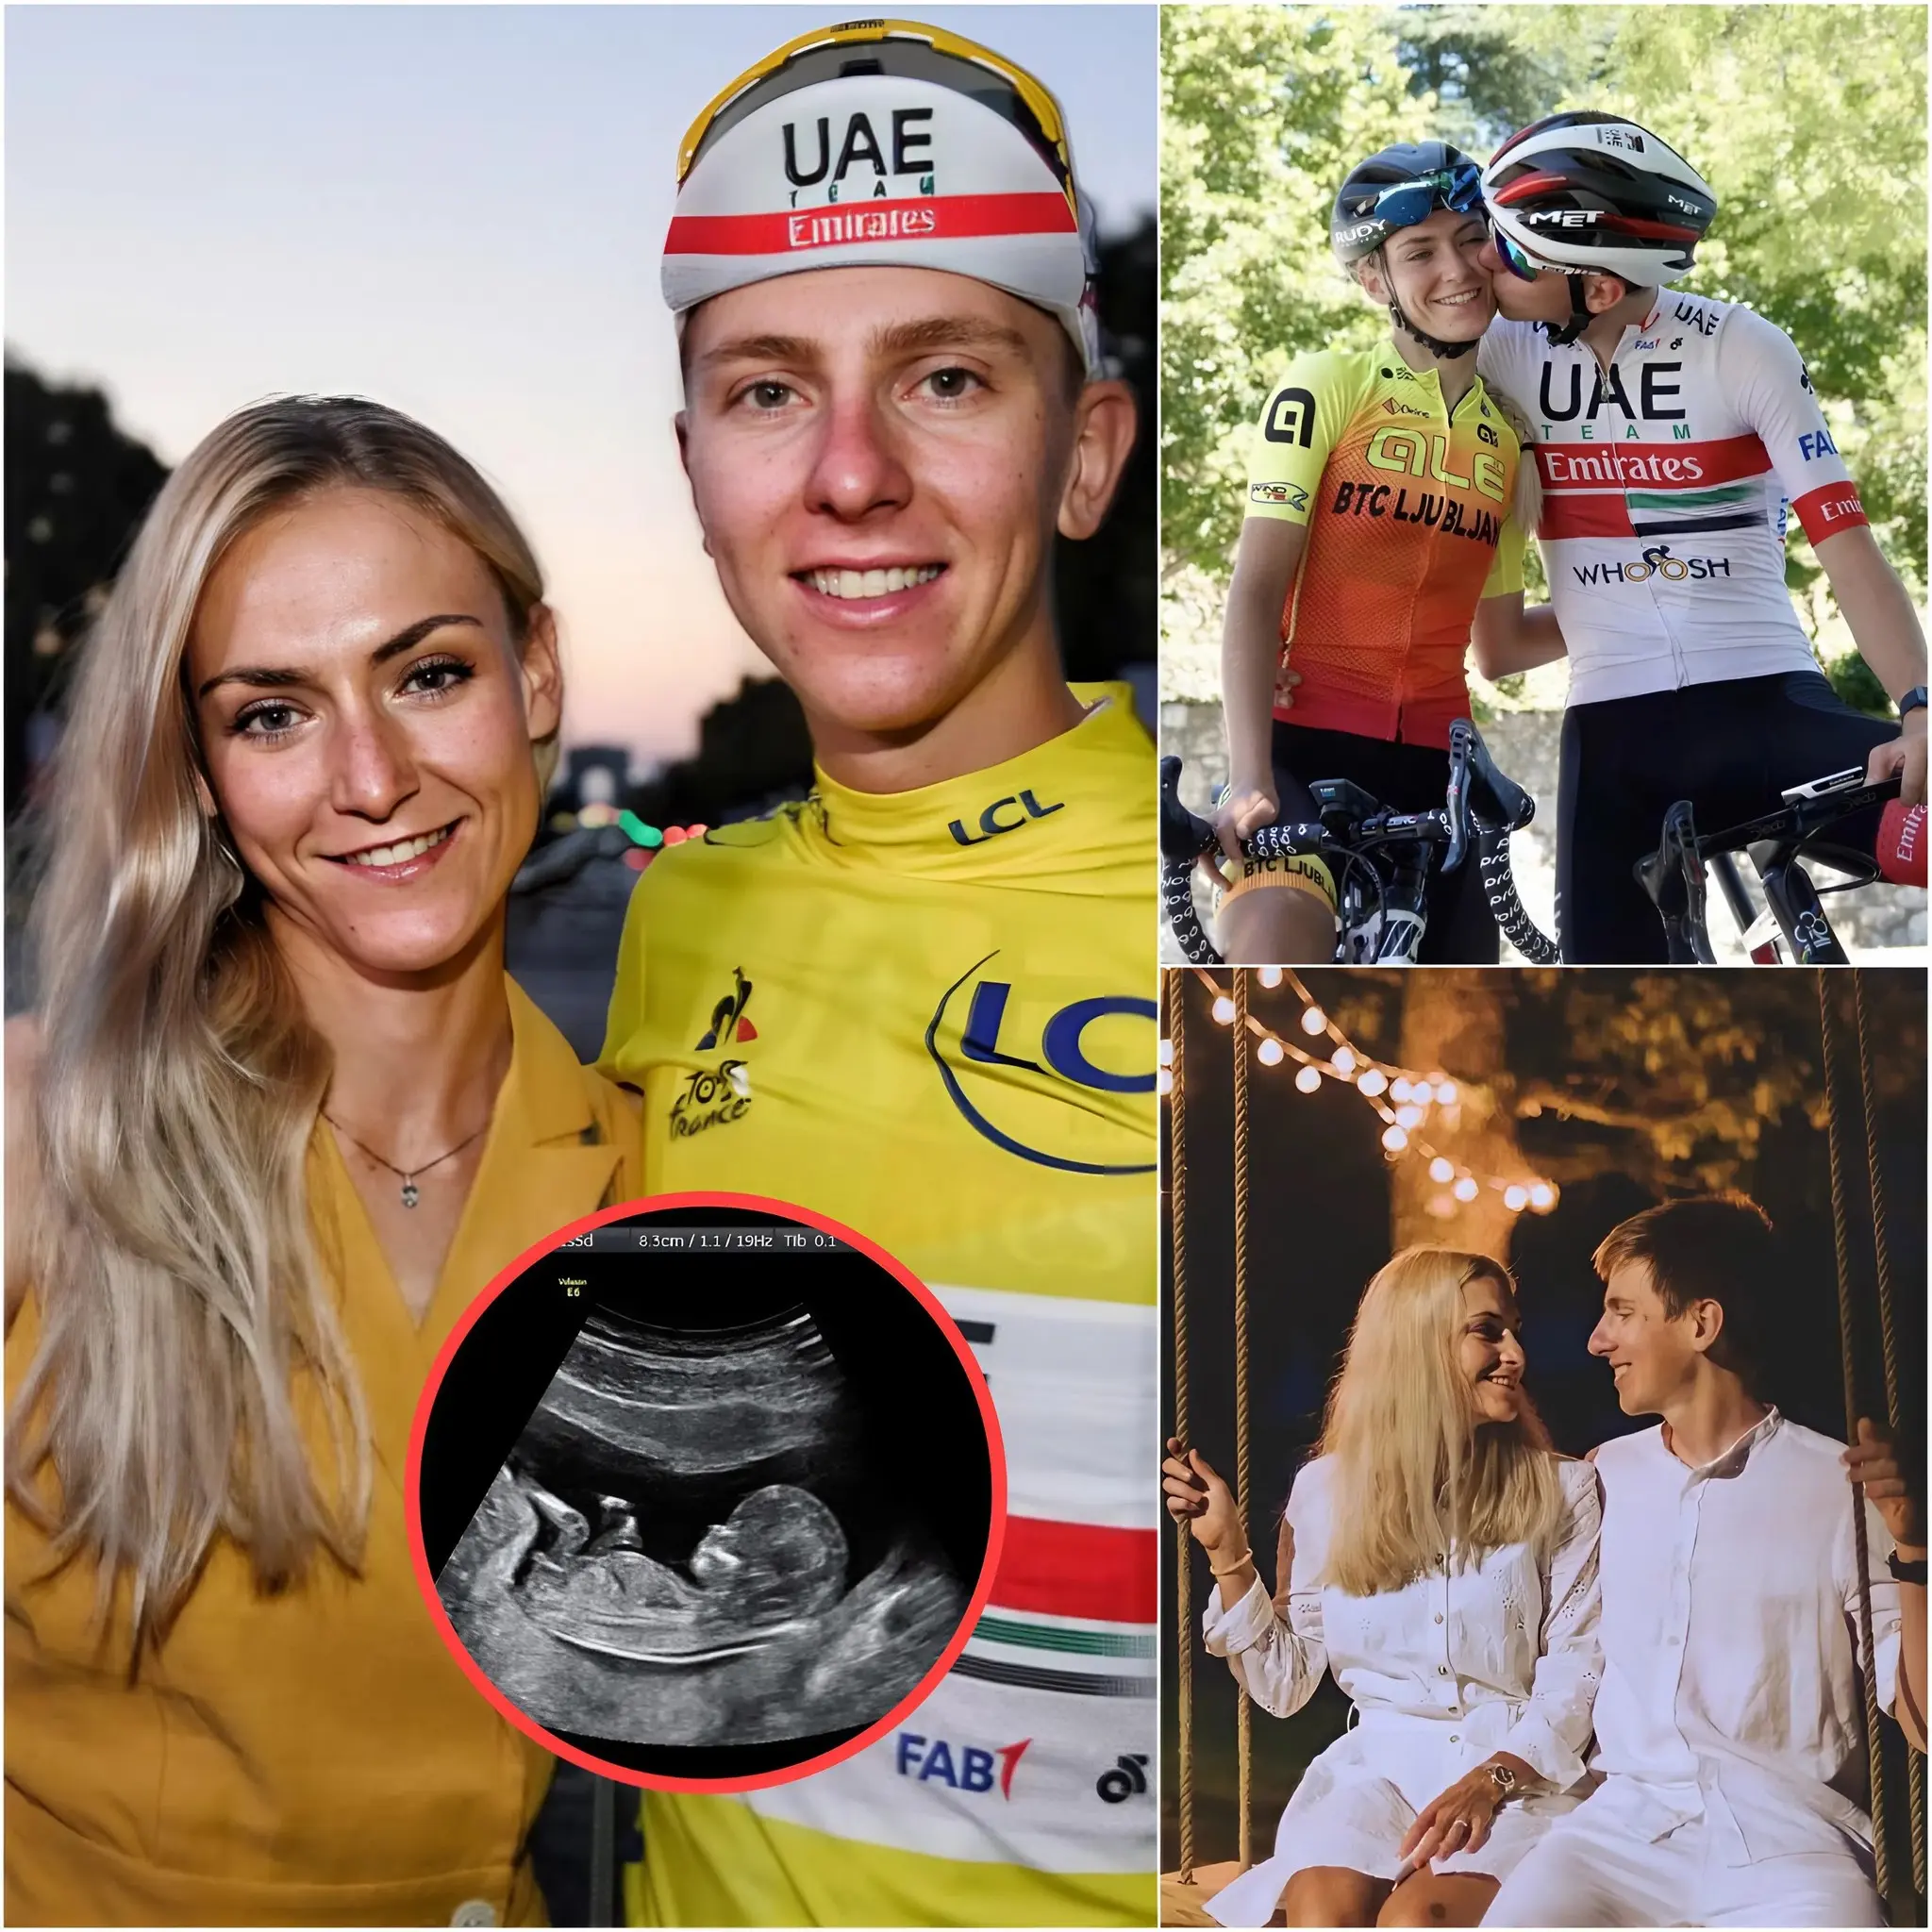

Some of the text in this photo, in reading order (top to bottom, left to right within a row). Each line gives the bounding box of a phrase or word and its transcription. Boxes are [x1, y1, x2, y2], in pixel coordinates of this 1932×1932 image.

[782, 108, 934, 187] UAE
[1528, 209, 1606, 228] MET
[1668, 194, 1703, 215] MET
[788, 208, 936, 247] Emirates
[1335, 219, 1386, 243] RUDY
[1674, 301, 1720, 336] UAE
[1539, 361, 1687, 422] UAE
[1541, 424, 1691, 441] TEAM
[1544, 449, 1704, 483] Emirates
[1332, 480, 1391, 517] BTC
[1573, 558, 1731, 586] WHOOSH
[948, 789, 1065, 846] LCL
[1244, 858, 1277, 879] BTC
[639, 1234, 685, 1248] 8.3cm
[700, 1235, 721, 1248] 1.1
[737, 1234, 774, 1248] 19Hz
[814, 1235, 837, 1248] 0.1
